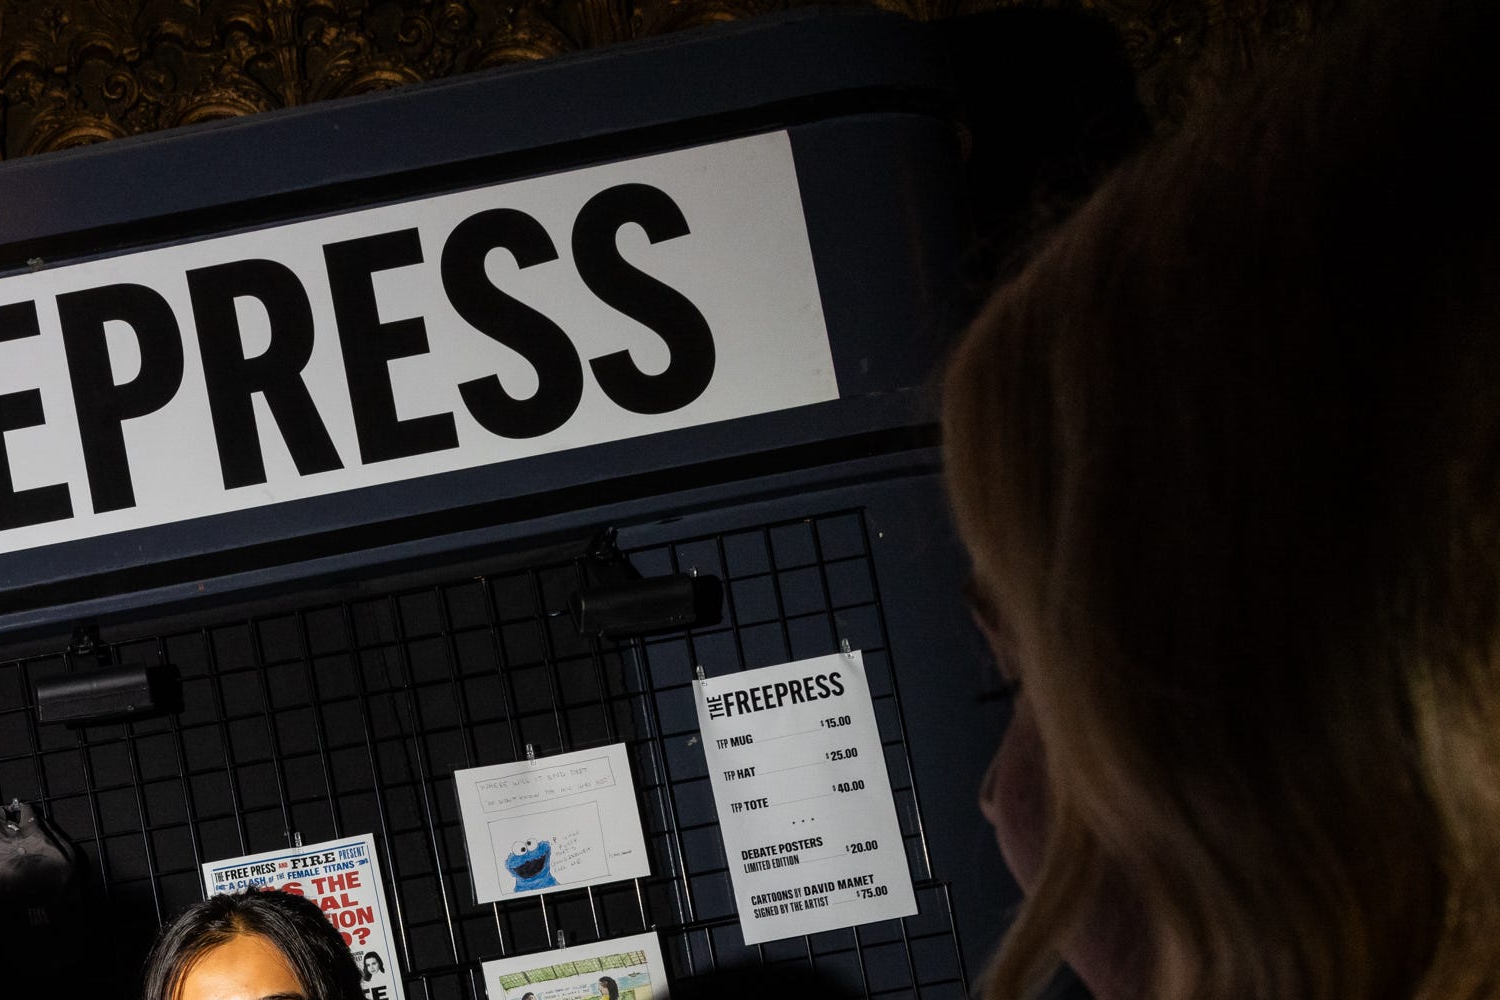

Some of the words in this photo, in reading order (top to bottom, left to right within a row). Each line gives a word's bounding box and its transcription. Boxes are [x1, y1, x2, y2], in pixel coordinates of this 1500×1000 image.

[706, 694, 725, 720] THE
[716, 738, 729, 750] TFP
[730, 734, 753, 748] MUG
[724, 770, 736, 782] TFP
[737, 767, 756, 780] HAT
[730, 803, 743, 814] TFP
[744, 798, 770, 812] TOTE
[741, 843, 778, 861] DEBATE
[778, 836, 824, 854] POSTERS
[214, 872, 225, 883] THE
[225, 867, 249, 881] FREE
[250, 862, 276, 878] PRESS
[278, 862, 288, 870] AND
[290, 852, 336, 870] FIRE
[338, 846, 366, 861] PRESENT
[228, 882, 236, 890] A
[237, 876, 266, 890] CLASH
[276, 872, 285, 881] THE
[287, 867, 320, 880] FEMALE
[324, 860, 356, 874] TITANS
[744, 859, 772, 874] LIMITED
[772, 855, 800, 869] EDITION
[311, 870, 362, 895] THE
[751, 888, 794, 906] CARTOONS
[793, 886, 802, 899] BY
[804, 881, 836, 897] DAVID
[837, 874, 875, 891] MAMET
[754, 904, 780, 919] SIGNED
[780, 903, 790, 914] BY
[790, 900, 804, 912] THE
[804, 896, 830, 910] ARTIST
